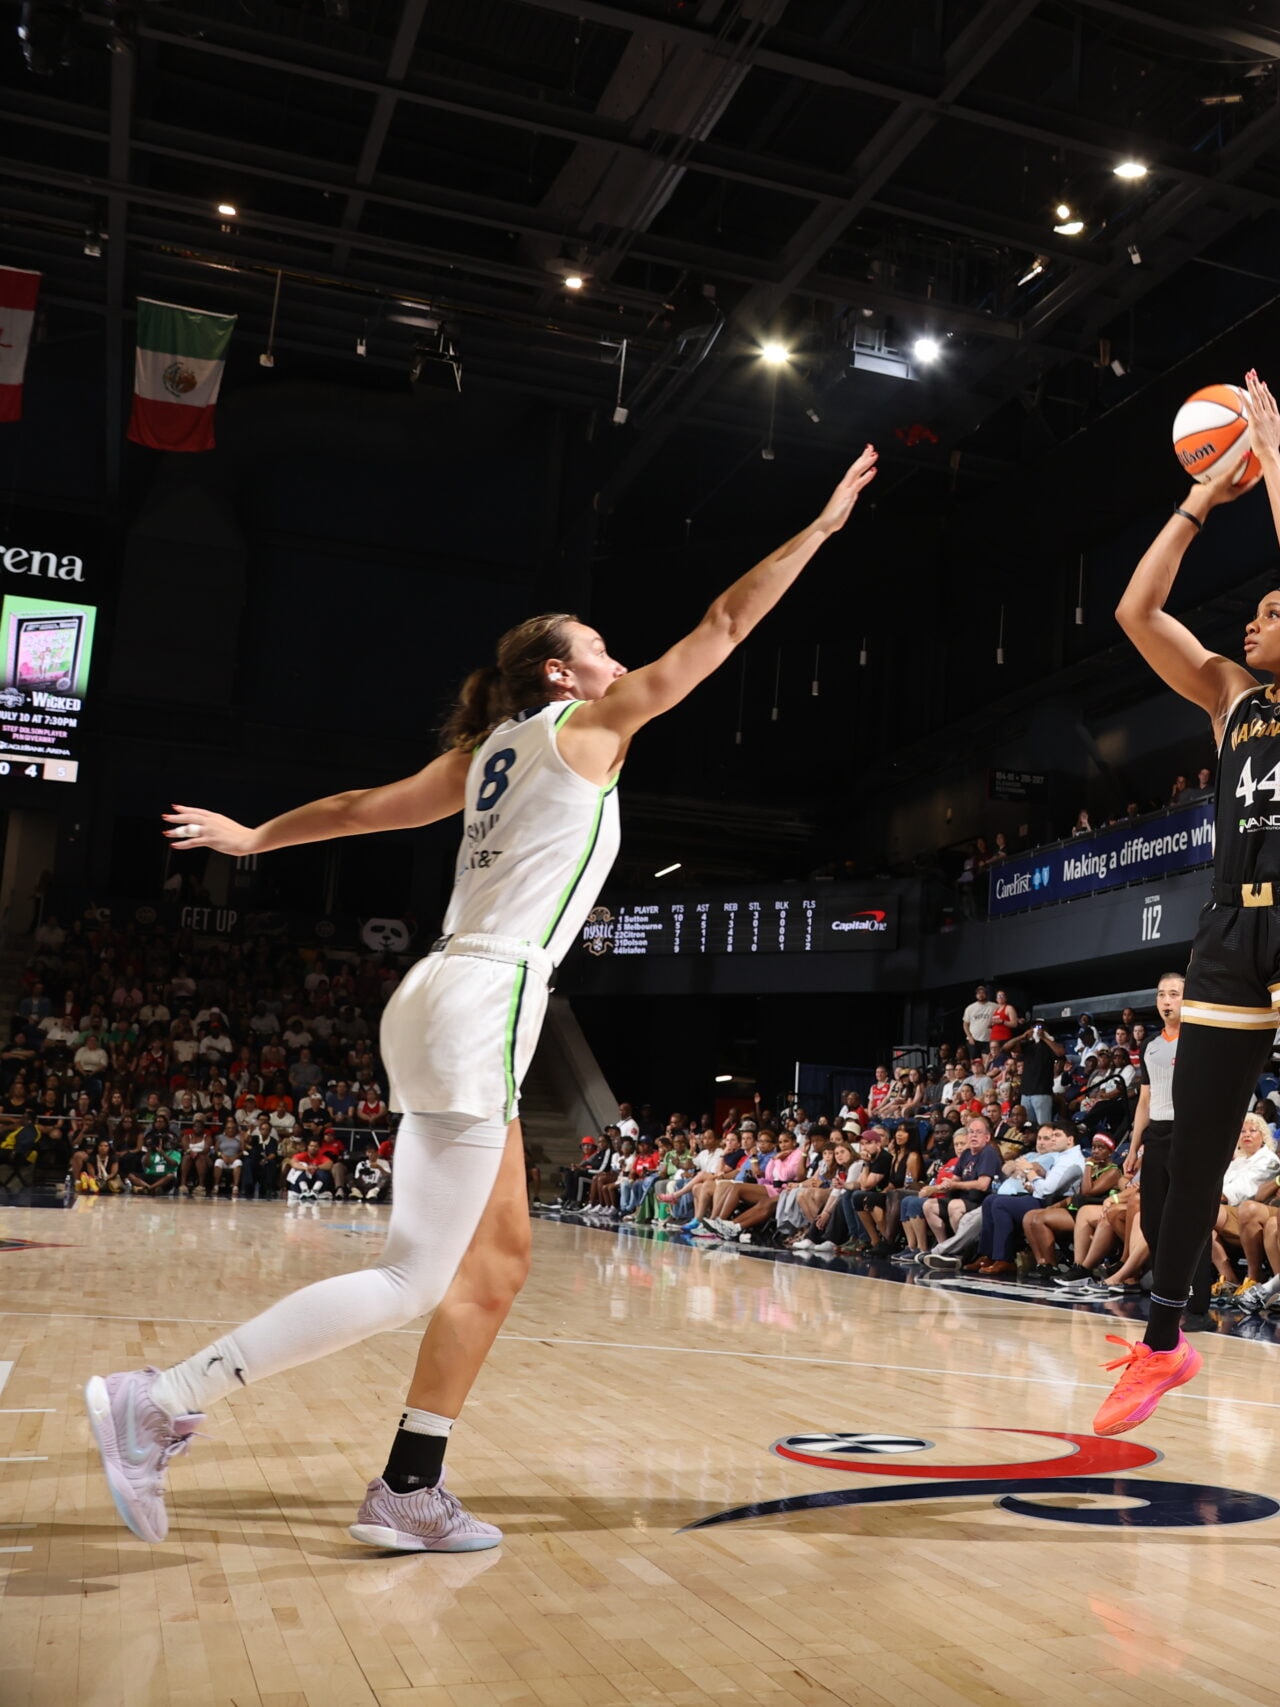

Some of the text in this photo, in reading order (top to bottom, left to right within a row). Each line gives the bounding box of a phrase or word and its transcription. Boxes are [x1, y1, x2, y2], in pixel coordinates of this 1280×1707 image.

[0, 545, 85, 582] ena
[19, 712, 31, 723] 10
[32, 714, 43, 724] AT
[44, 715, 77, 728] 7:30PM
[24, 764, 37, 777] 4
[476, 748, 516, 811] 8
[996, 818, 1213, 900] CareFirst Making a difference wh
[634, 905, 659, 914] PLAYER
[671, 904, 684, 913] PTS
[696, 904, 710, 912] AST
[724, 903, 738, 911] REB
[748, 902, 761, 911] STL
[775, 901, 789, 910] BLK
[803, 900, 816, 909] FLS
[216, 909, 238, 933] UP
[673, 913, 684, 922] 10
[701, 912, 707, 921] 4
[753, 911, 759, 919] 3
[780, 910, 786, 919] 0
[806, 909, 812, 918] 0
[1142, 904, 1162, 941] 112
[623, 923, 663, 932] Melbourne
[780, 918, 786, 927] 0
[779, 926, 785, 935] 0
[778, 934, 785, 943] 0
[805, 942, 811, 951] 2
